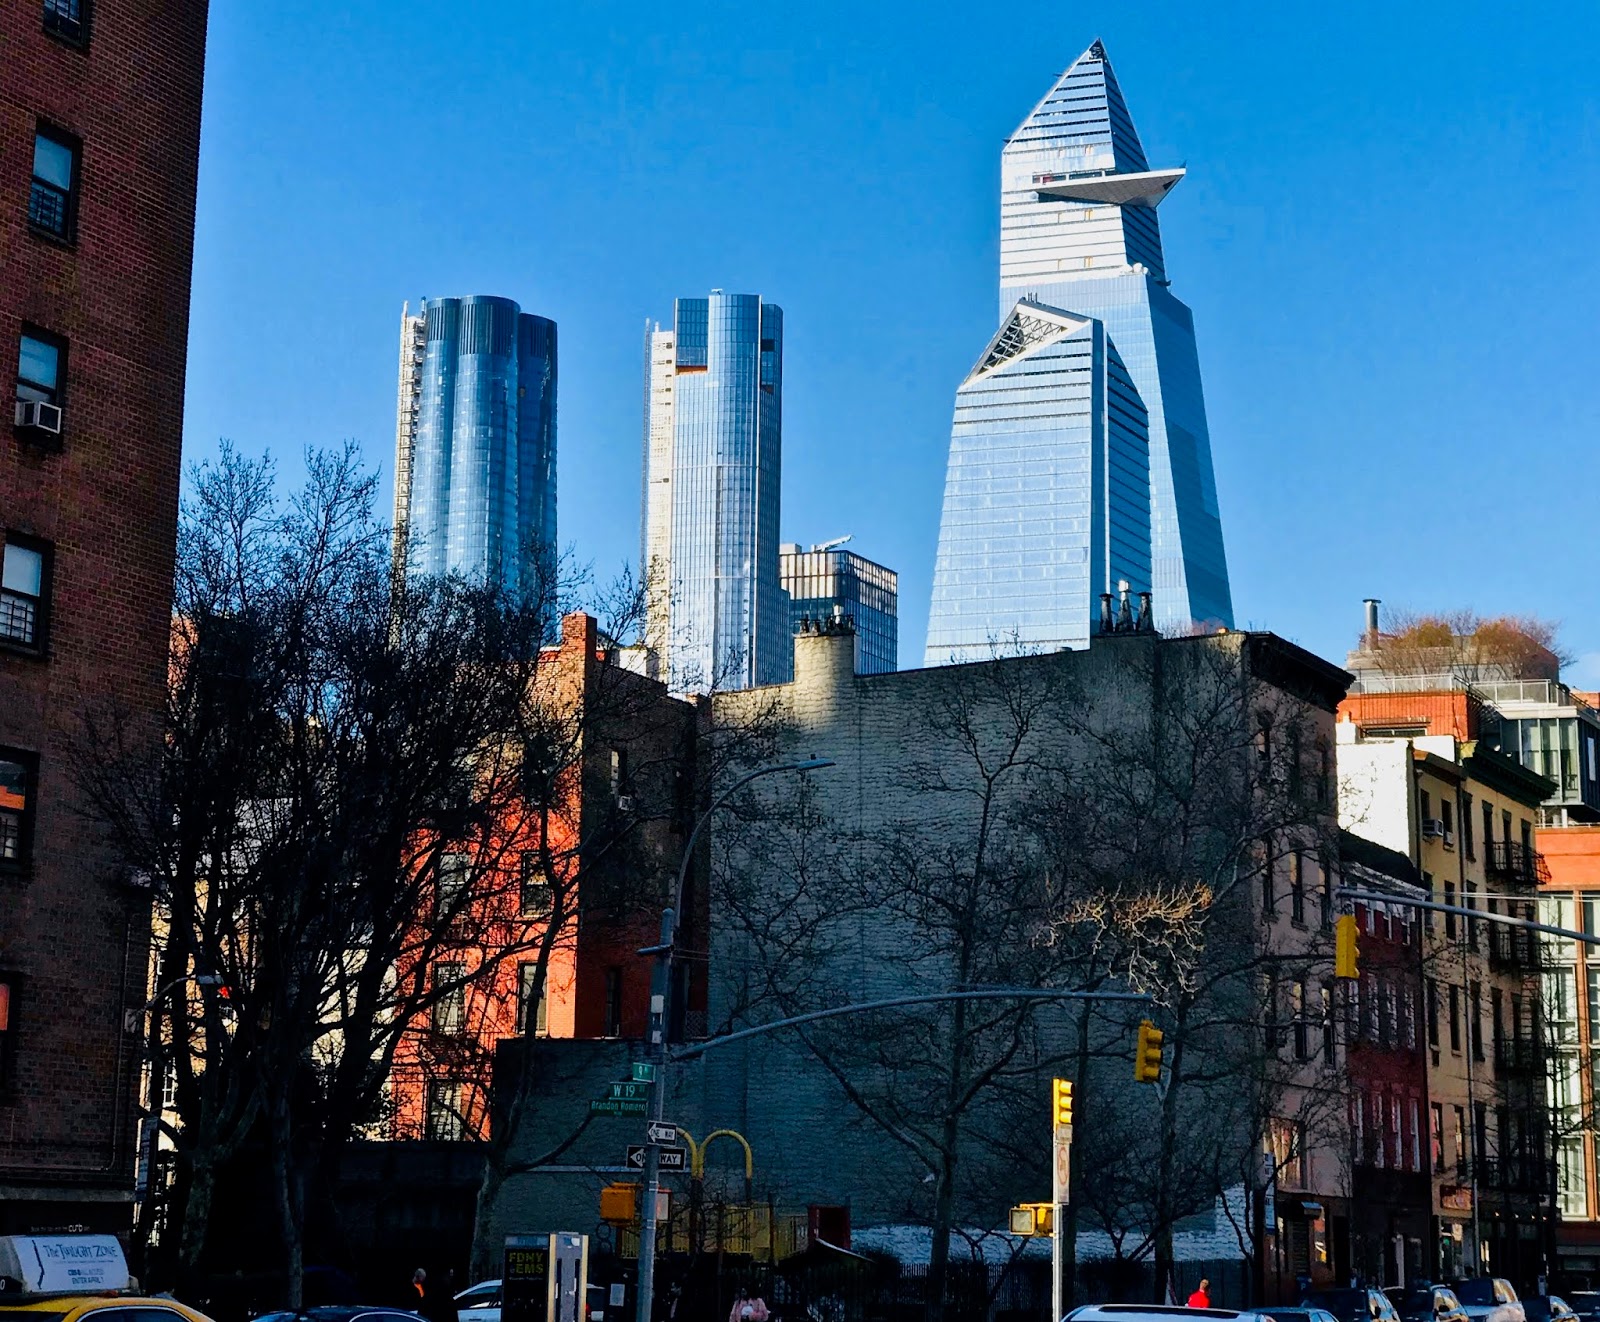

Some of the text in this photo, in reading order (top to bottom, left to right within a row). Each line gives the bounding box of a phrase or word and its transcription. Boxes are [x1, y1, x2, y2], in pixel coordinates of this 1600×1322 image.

[613, 1084, 622, 1097] W
[625, 1085, 636, 1098] 19
[591, 1100, 646, 1112] Brandon Romero
[651, 1128, 674, 1138] ONE WAY
[660, 1154, 677, 1163] WAY
[68, 1223, 83, 1233] curb
[92, 1245, 118, 1258] ZONE
[508, 1252, 544, 1263] FDNY
[515, 1263, 544, 1274] EMS
